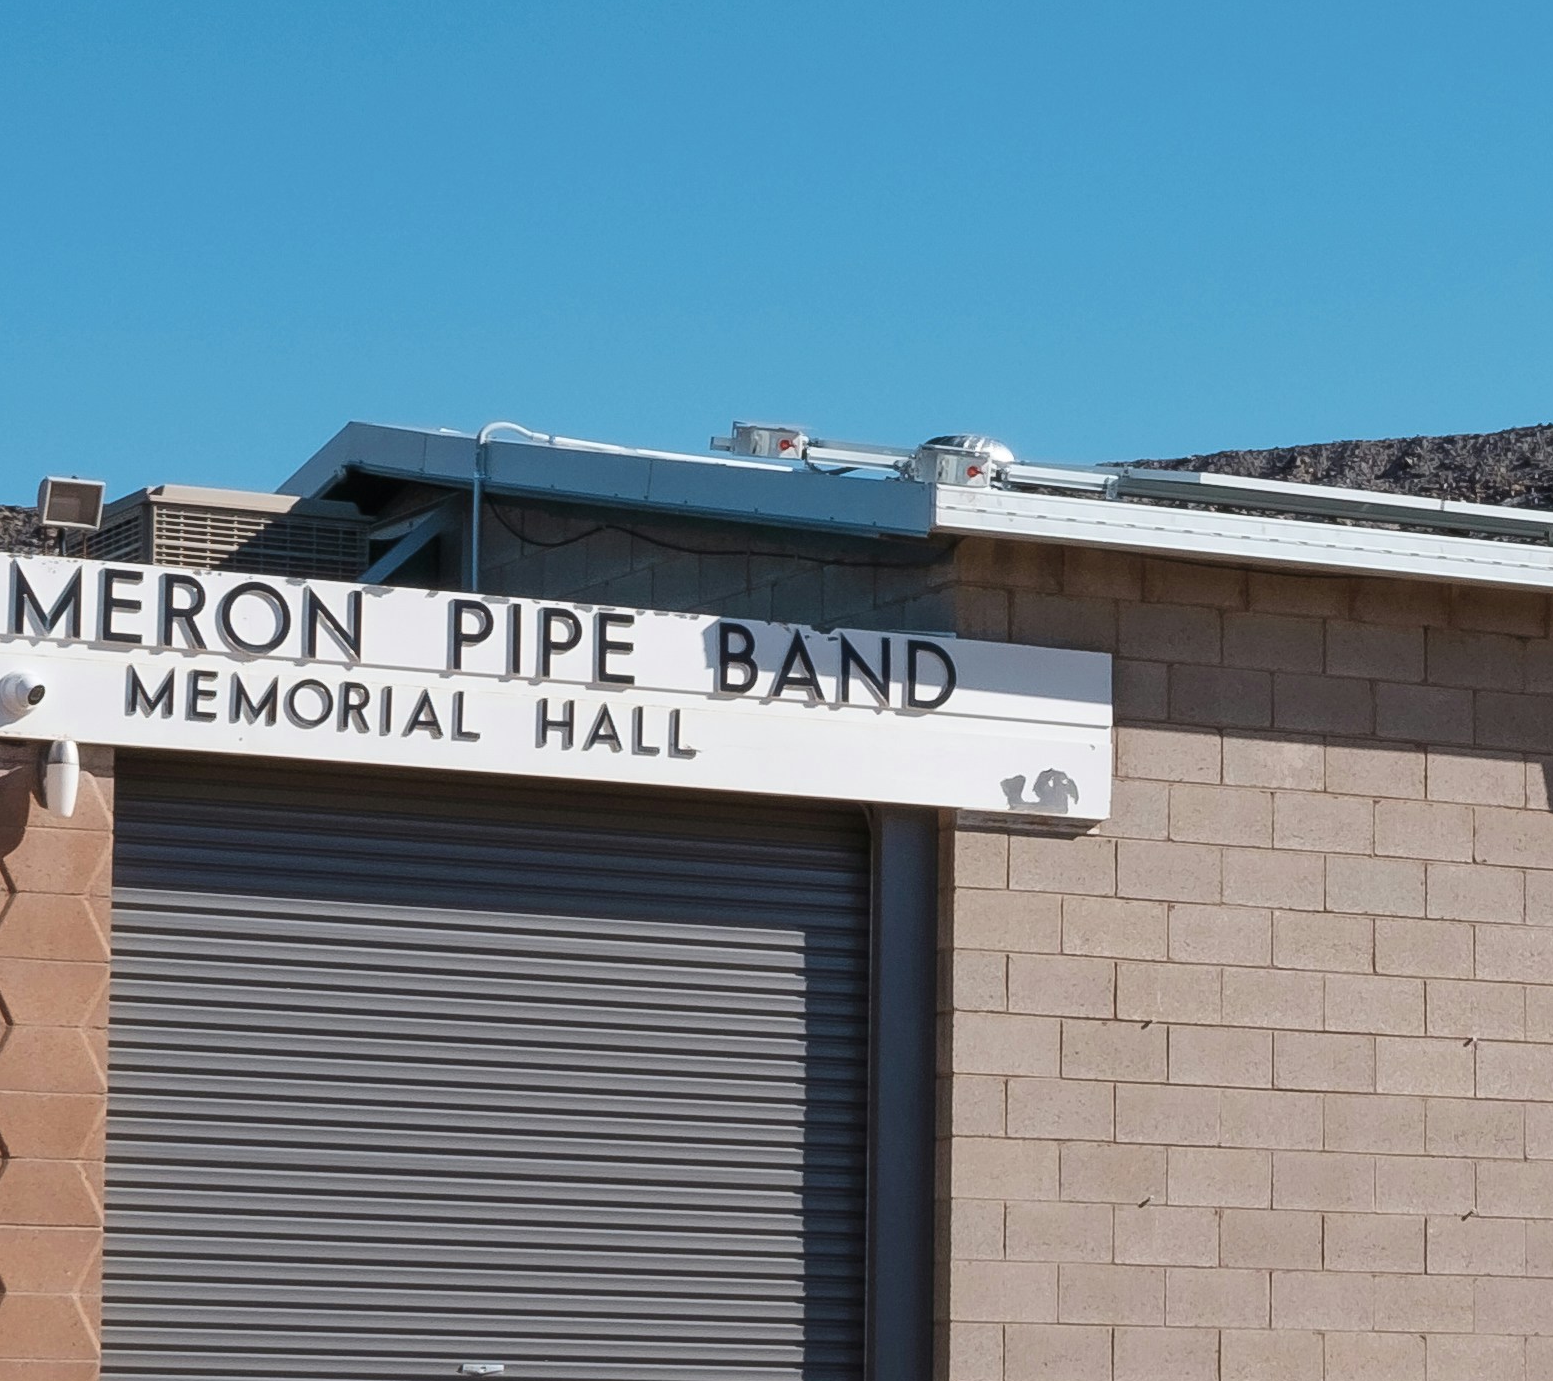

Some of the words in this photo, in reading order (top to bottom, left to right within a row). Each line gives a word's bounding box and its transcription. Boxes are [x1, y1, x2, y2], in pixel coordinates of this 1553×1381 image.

[450, 599, 636, 685] PIPE
[717, 621, 957, 710] BAND
[126, 665, 481, 743] MEMORIAL
[537, 697, 697, 758] HALL
